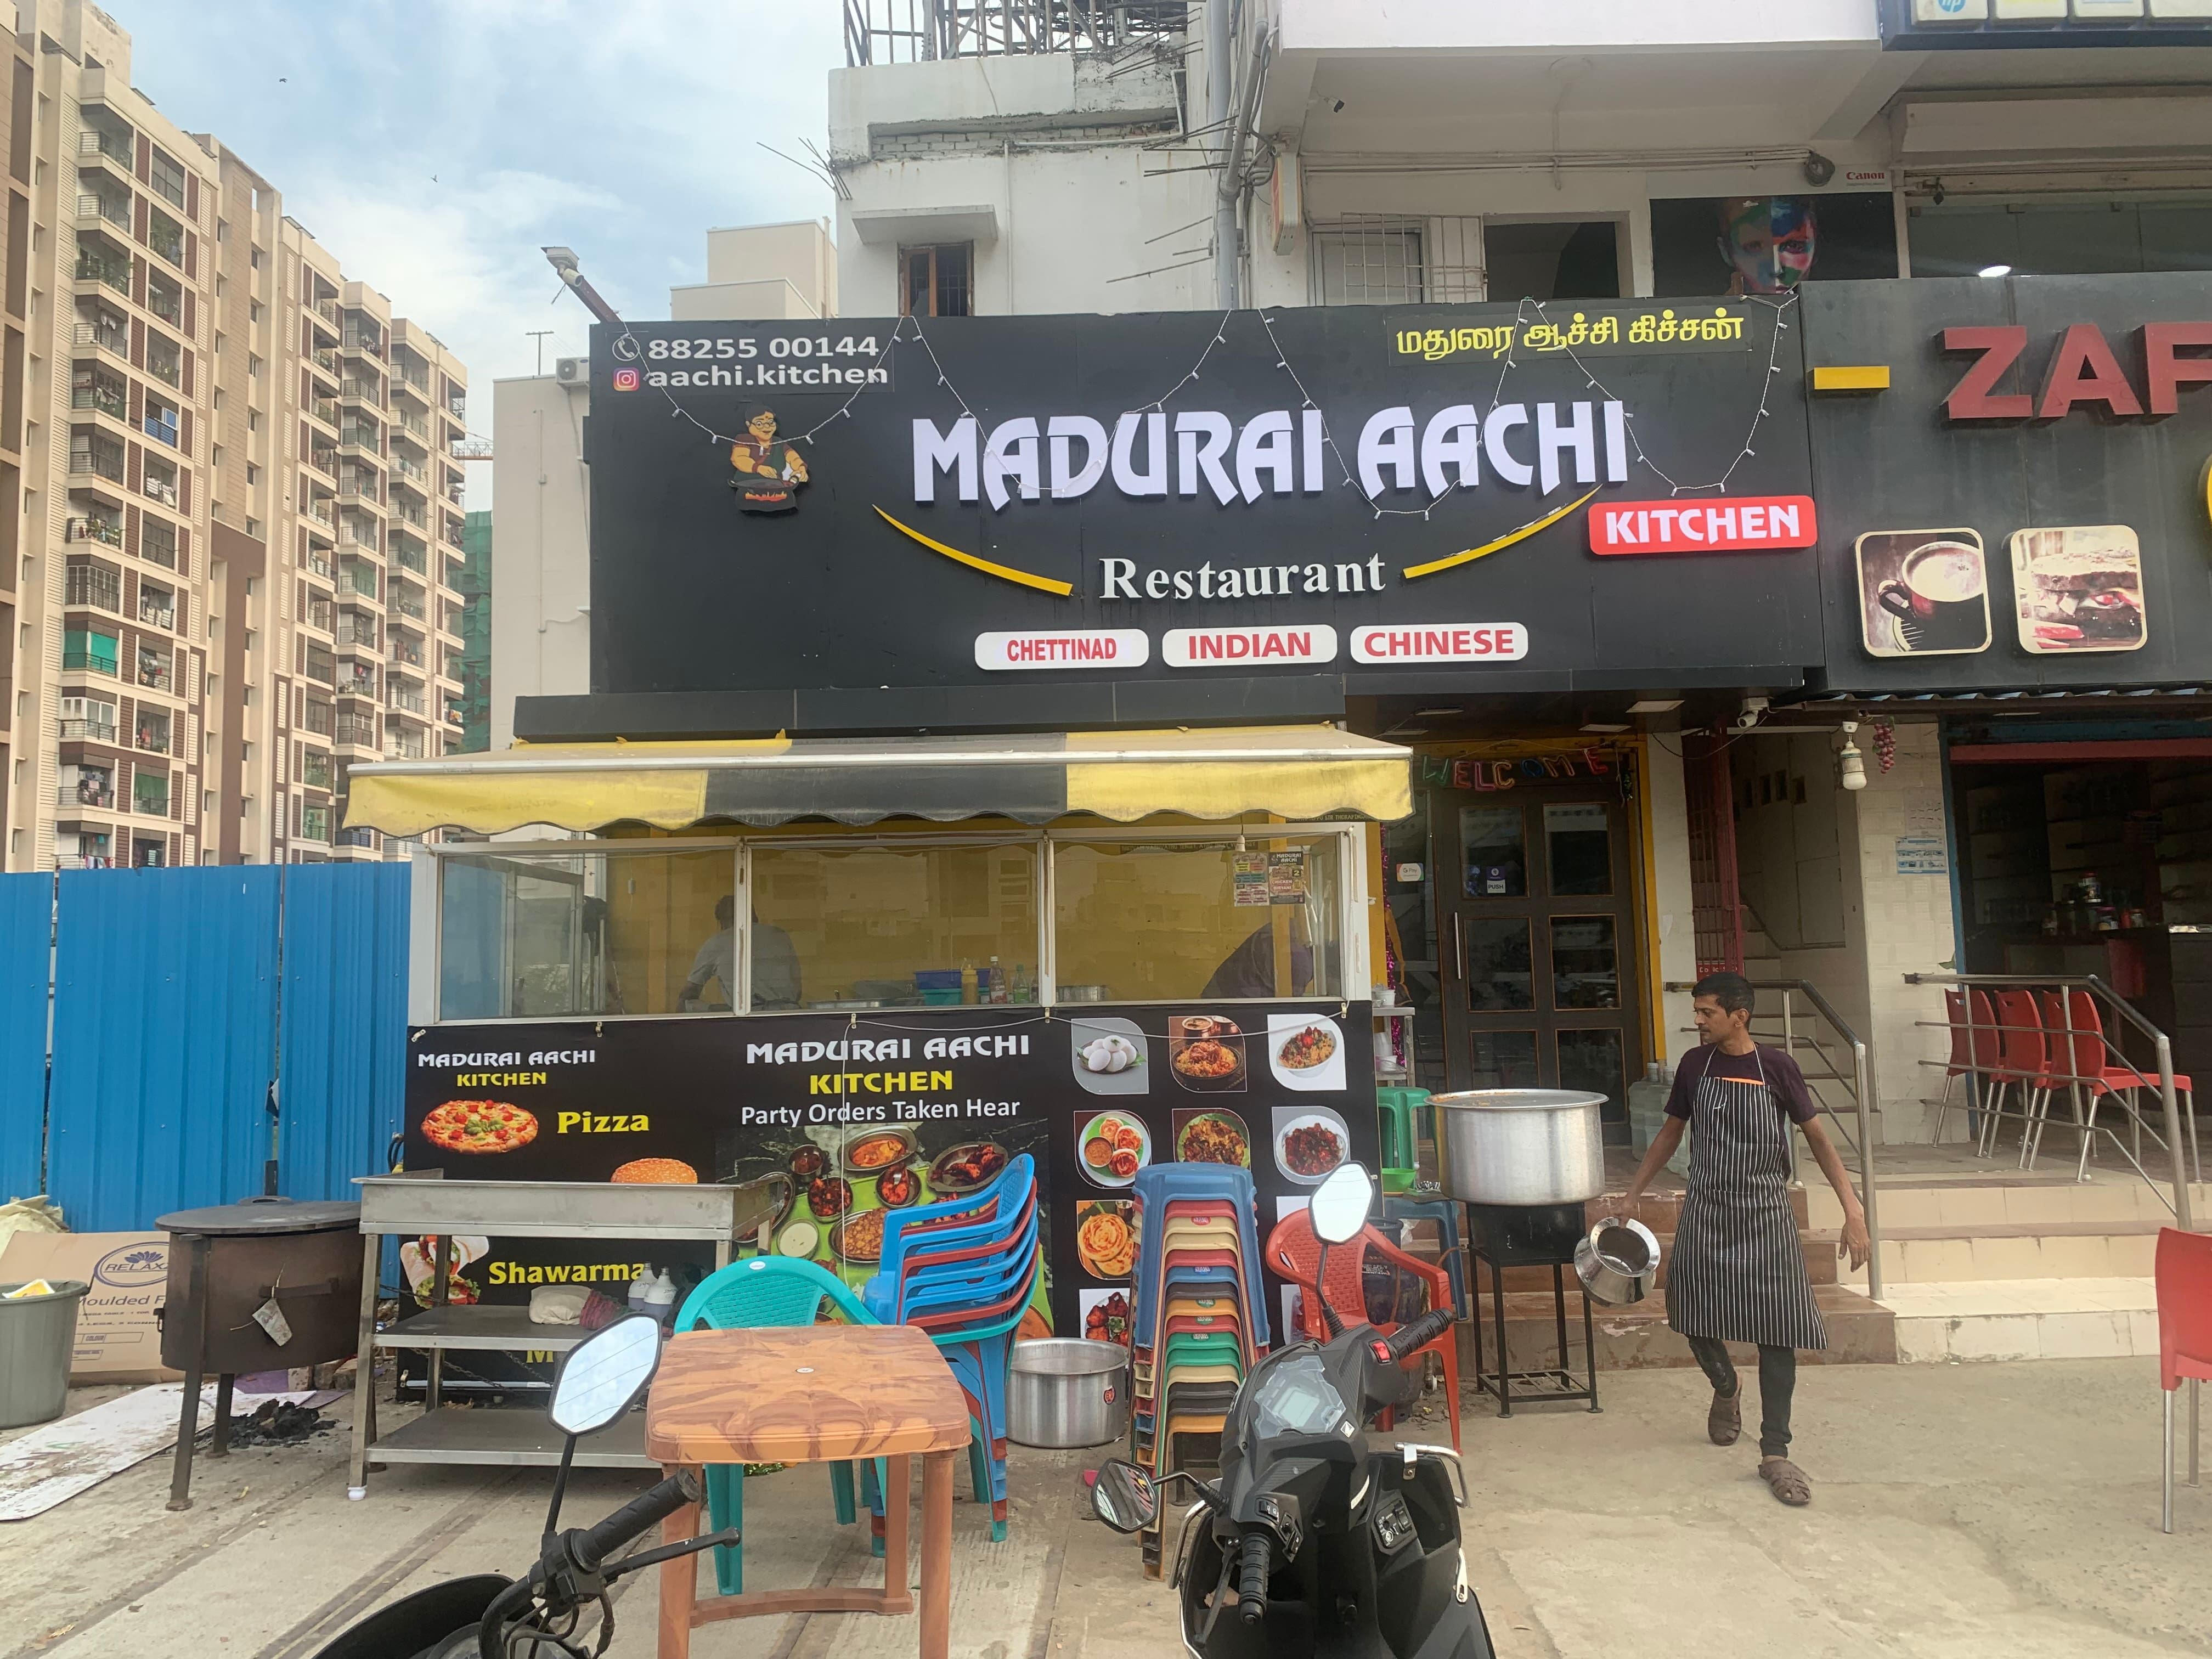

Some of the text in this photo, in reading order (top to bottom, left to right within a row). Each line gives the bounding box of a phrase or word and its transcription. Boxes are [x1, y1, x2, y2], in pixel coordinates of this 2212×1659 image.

[1846, 171, 1885, 180] Canon
[1396, 307, 1743, 360] மதுரை ஆச்சி கிச்சன்
[648, 336, 879, 359] 88255 00144
[648, 363, 888, 386] aachi.kitchen
[913, 400, 1628, 511] MADURAI AACHI
[1606, 505, 1800, 545] KITCHEN
[1099, 553, 1386, 600] Restaurant
[1007, 638, 1116, 662] CHETTINAD
[1189, 632, 1311, 659] INDIAN
[1364, 630, 1514, 657] CHINESE
[418, 1049, 596, 1068] MADURAI AACHI
[747, 1035, 1029, 1065] MADURAI AACHI
[457, 1072, 546, 1087] KITCHEN
[810, 1070, 952, 1094] KITCHEN
[557, 1111, 650, 1133] Pizza
[742, 1098, 1020, 1128] Party Orders Taken Hear
[105, 1263, 168, 1271] RELAX
[489, 1262, 644, 1284] Shawarma
